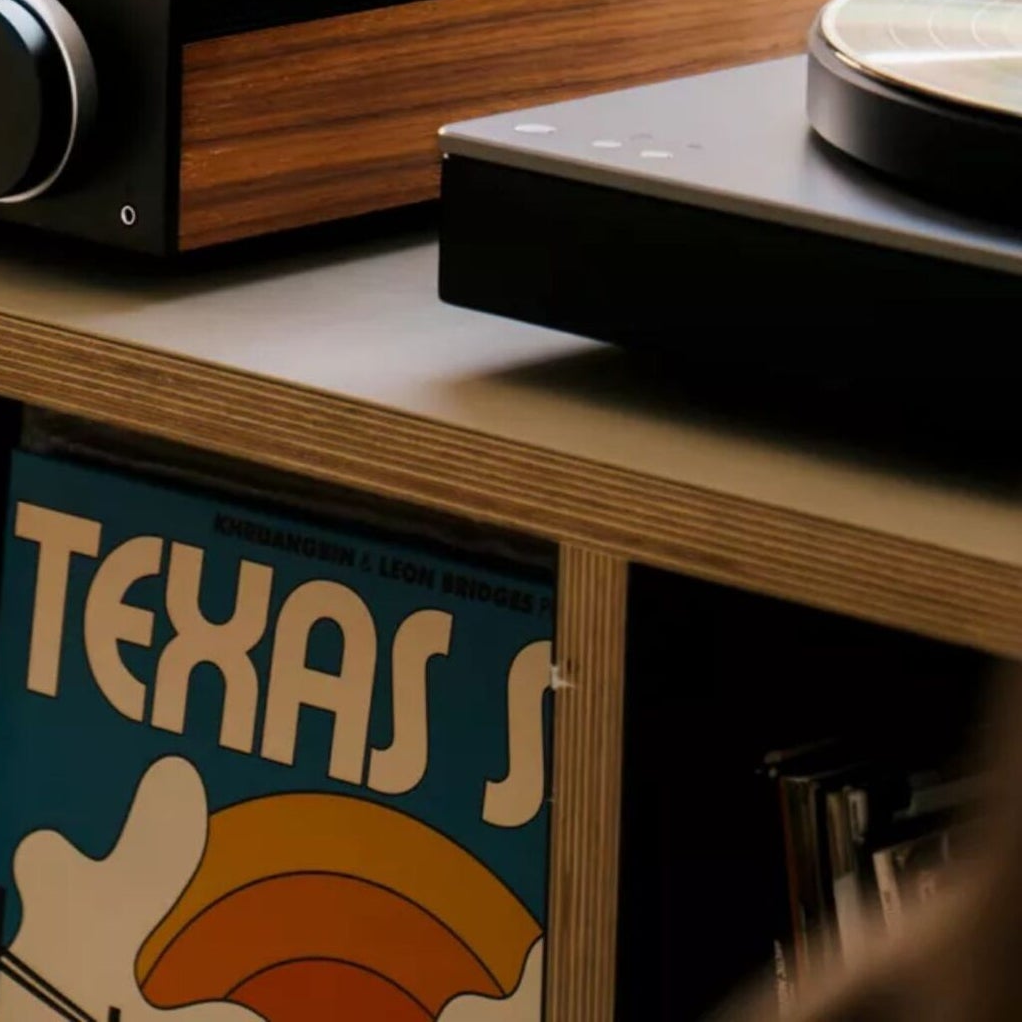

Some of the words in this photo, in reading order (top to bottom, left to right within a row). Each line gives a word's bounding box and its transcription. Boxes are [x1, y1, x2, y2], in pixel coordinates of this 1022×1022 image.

[14, 500, 454, 796] TEXAS
[379, 556, 436, 591] LEON
[442, 570, 535, 615] BRIDGES
